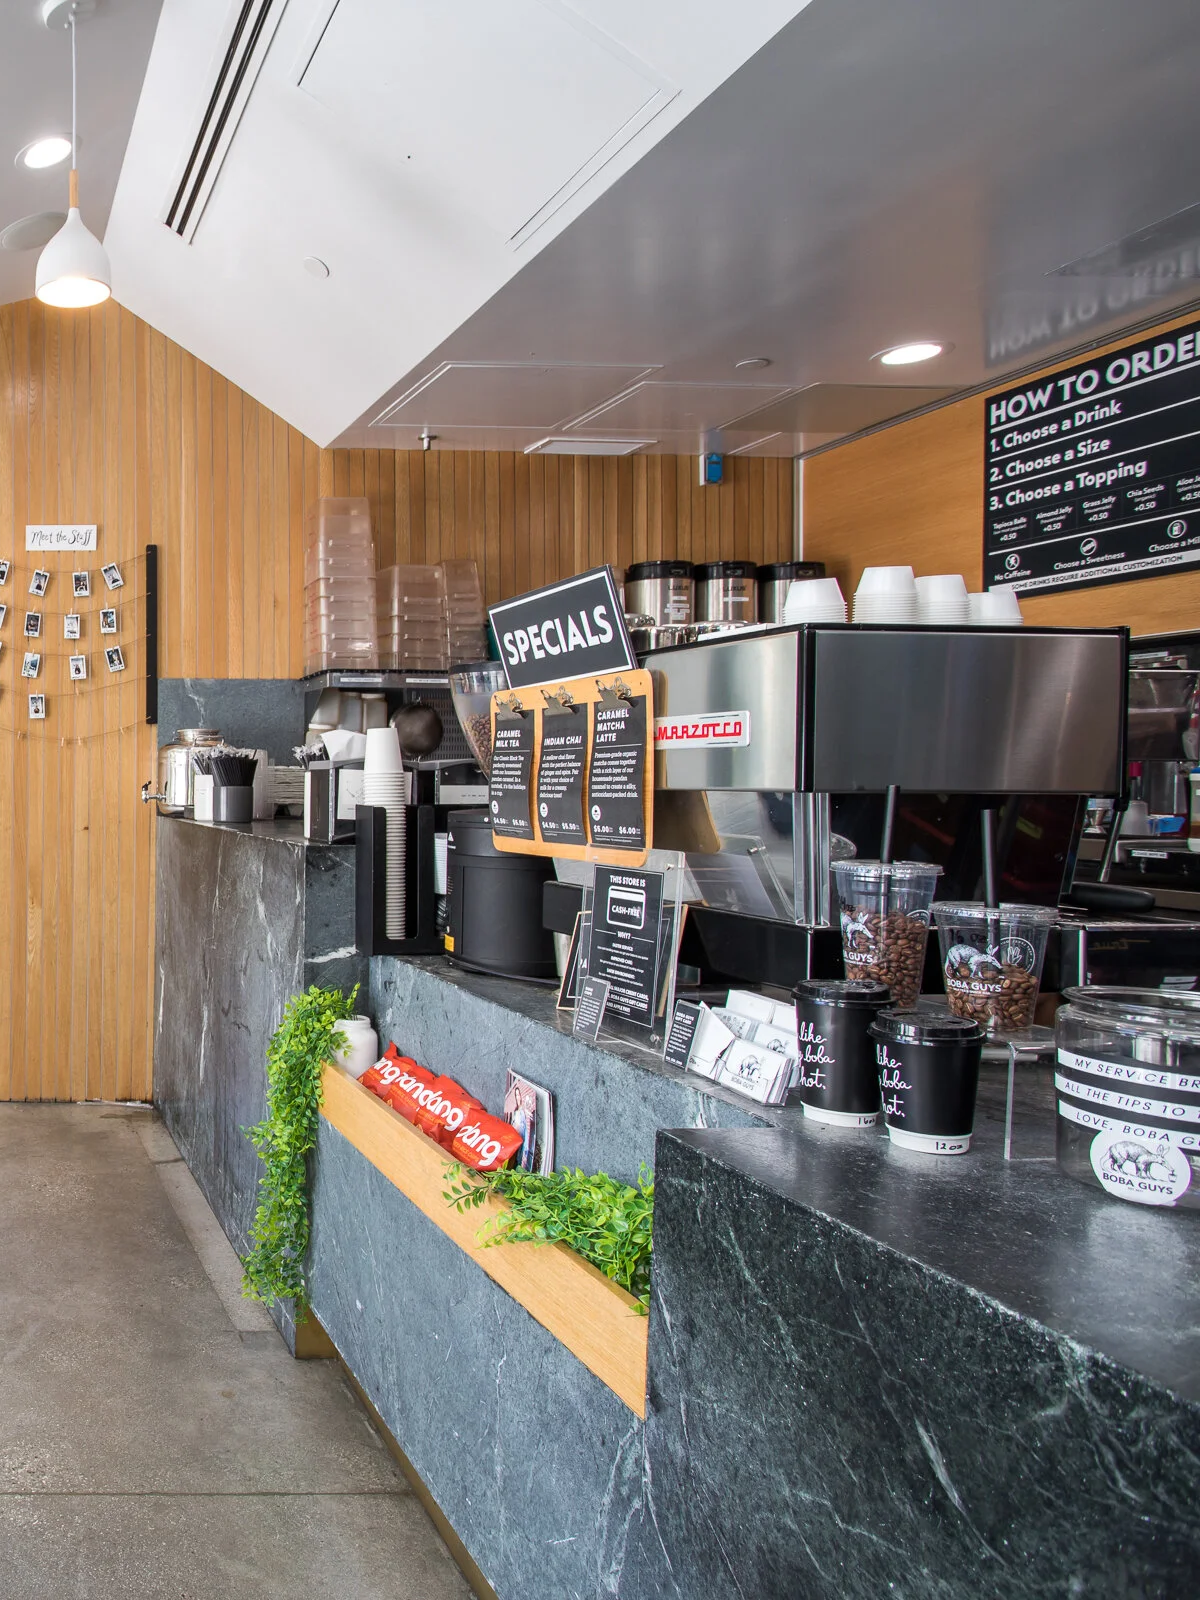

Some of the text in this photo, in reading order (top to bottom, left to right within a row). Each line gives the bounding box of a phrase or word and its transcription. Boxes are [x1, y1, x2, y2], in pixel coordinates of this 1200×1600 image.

[990, 331, 1200, 425] HOW TO ORDE
[990, 399, 1122, 452] 1. Choose a Drink
[990, 439, 1111, 482] 2. Choose a Size
[990, 461, 1147, 510] 3. Choose a Topping
[1127, 484, 1165, 498] Chia Seeds
[1083, 495, 1117, 508] Grass Jelly
[1134, 501, 1156, 511] +0.50
[1036, 506, 1073, 520] Almond Jelly
[1088, 511, 1109, 521] +0.50
[993, 517, 1027, 530] Tapioca Balls
[1043, 522, 1062, 532] +0.50
[32, 530, 52, 546] Meet
[57, 530, 67, 542] the
[1000, 532, 1017, 541] +0.50
[1149, 542, 1179, 552] Choose
[1054, 560, 1079, 570] Choose
[1086, 552, 1126, 564] Sweetness
[1004, 569, 1032, 580] Caffeine
[1011, 555, 1183, 590] SOME DRINKS REQUIRE ADDITIONAL CUSTOMIZATION
[503, 605, 613, 666] SPECIALS
[597, 709, 629, 720] CARAMEL
[596, 721, 625, 731] MATCHA
[497, 730, 521, 738] CARAMEL
[544, 735, 582, 746] INDIAN CHAI
[596, 733, 616, 742] LATTE
[509, 739, 520, 747] TEA
[493, 817, 506, 825] $4.50
[542, 821, 576, 830] $4.50 $5.50
[594, 825, 636, 834] $5.00 $6.00
[610, 875, 646, 888] THIS STORE IS
[612, 905, 641, 917] CASH-FREE
[617, 931, 631, 940] WHY?
[848, 951, 873, 963] GUYS
[947, 978, 968, 989] BOBA
[971, 982, 1002, 992] GUYS
[799, 1021, 827, 1043] like
[804, 1045, 835, 1063] boba
[876, 1043, 902, 1068] like
[800, 1066, 826, 1089] hot.
[1074, 1058, 1091, 1069] MY
[1097, 1063, 1168, 1085] SERVICE
[882, 1069, 912, 1089] boba
[1065, 1082, 1081, 1094] ALL
[1086, 1088, 1110, 1101] THE
[1117, 1096, 1152, 1111] TIPS
[419, 1090, 464, 1131] dang
[881, 1091, 906, 1117] hot.
[1122, 1125, 1170, 1142] BOBA
[456, 1122, 501, 1167] dang
[1102, 1172, 1173, 1195] BOBA GUYS
